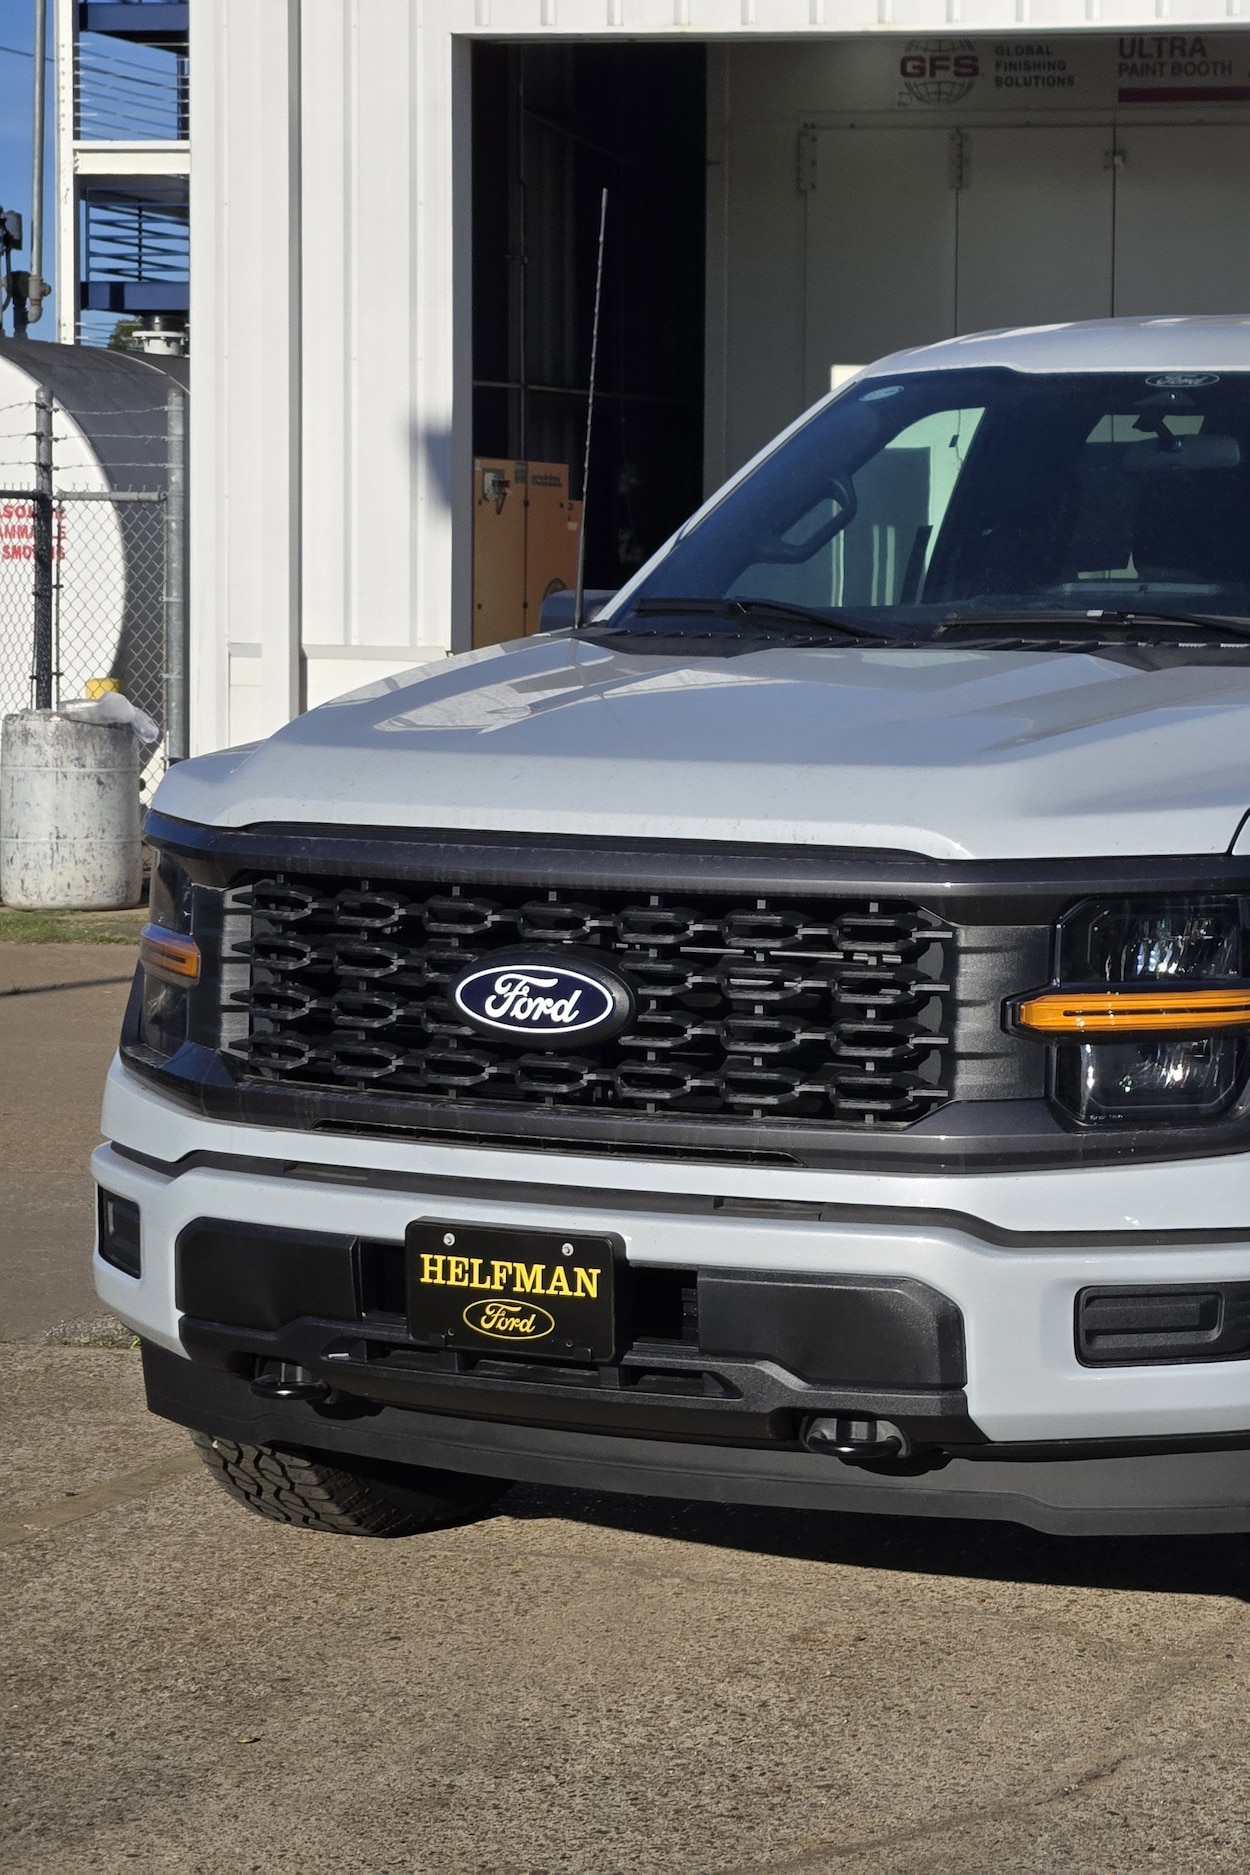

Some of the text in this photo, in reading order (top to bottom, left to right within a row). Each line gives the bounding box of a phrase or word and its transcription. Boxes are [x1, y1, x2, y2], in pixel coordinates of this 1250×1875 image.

[994, 44, 1053, 57] GLOBAL
[1118, 36, 1208, 59] ULTRA
[900, 54, 980, 79] GFS
[994, 59, 1067, 72] FINISHING
[1118, 60, 1234, 78] PAINT BOOTH
[994, 74, 1076, 88] SOLUTIONS
[485, 973, 583, 1023] Ford
[419, 1254, 602, 1298] HELFMAN
[480, 1302, 537, 1334] Ford
